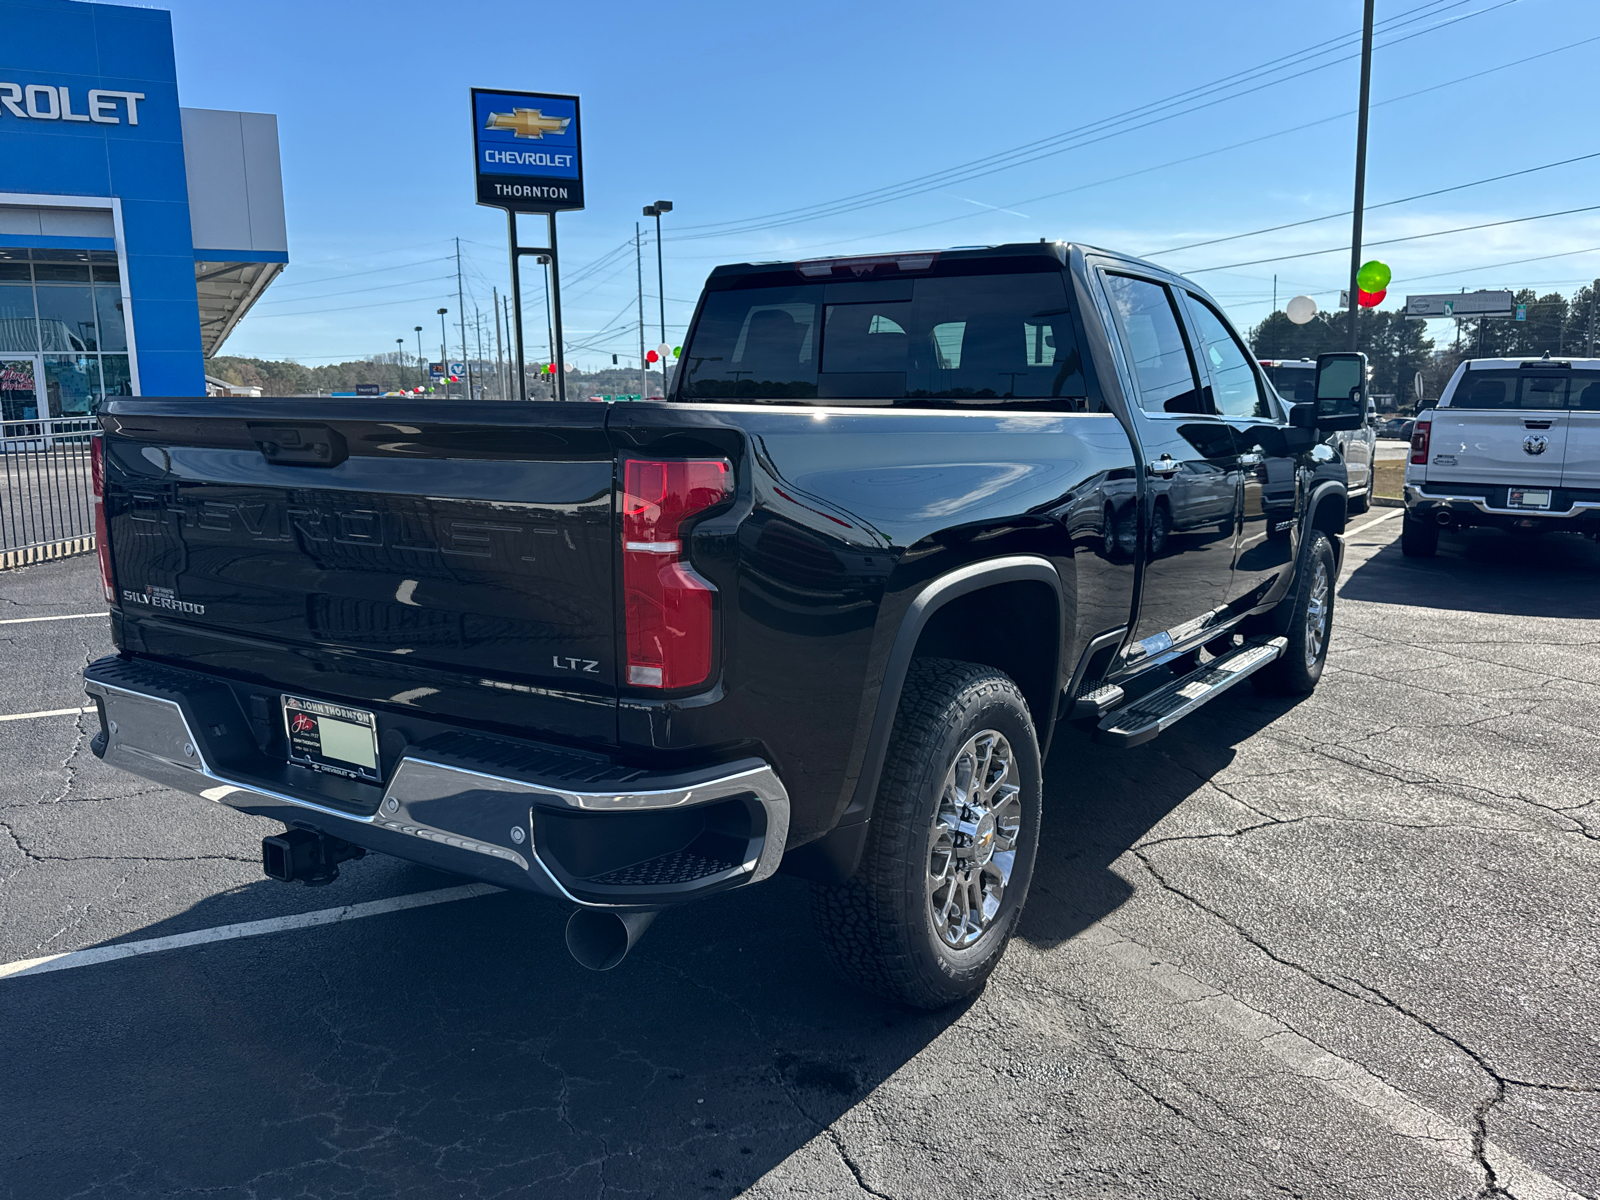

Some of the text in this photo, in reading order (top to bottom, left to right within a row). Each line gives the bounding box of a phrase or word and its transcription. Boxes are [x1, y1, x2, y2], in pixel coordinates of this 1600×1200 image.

[485, 150, 573, 168] CHEVROLET
[494, 184, 568, 199] THORNTON
[122, 590, 205, 615] SILVERADO
[552, 655, 600, 673] LTZ
[302, 701, 369, 722] JOHN THORNTON
[321, 765, 347, 776] CHEVROLET
